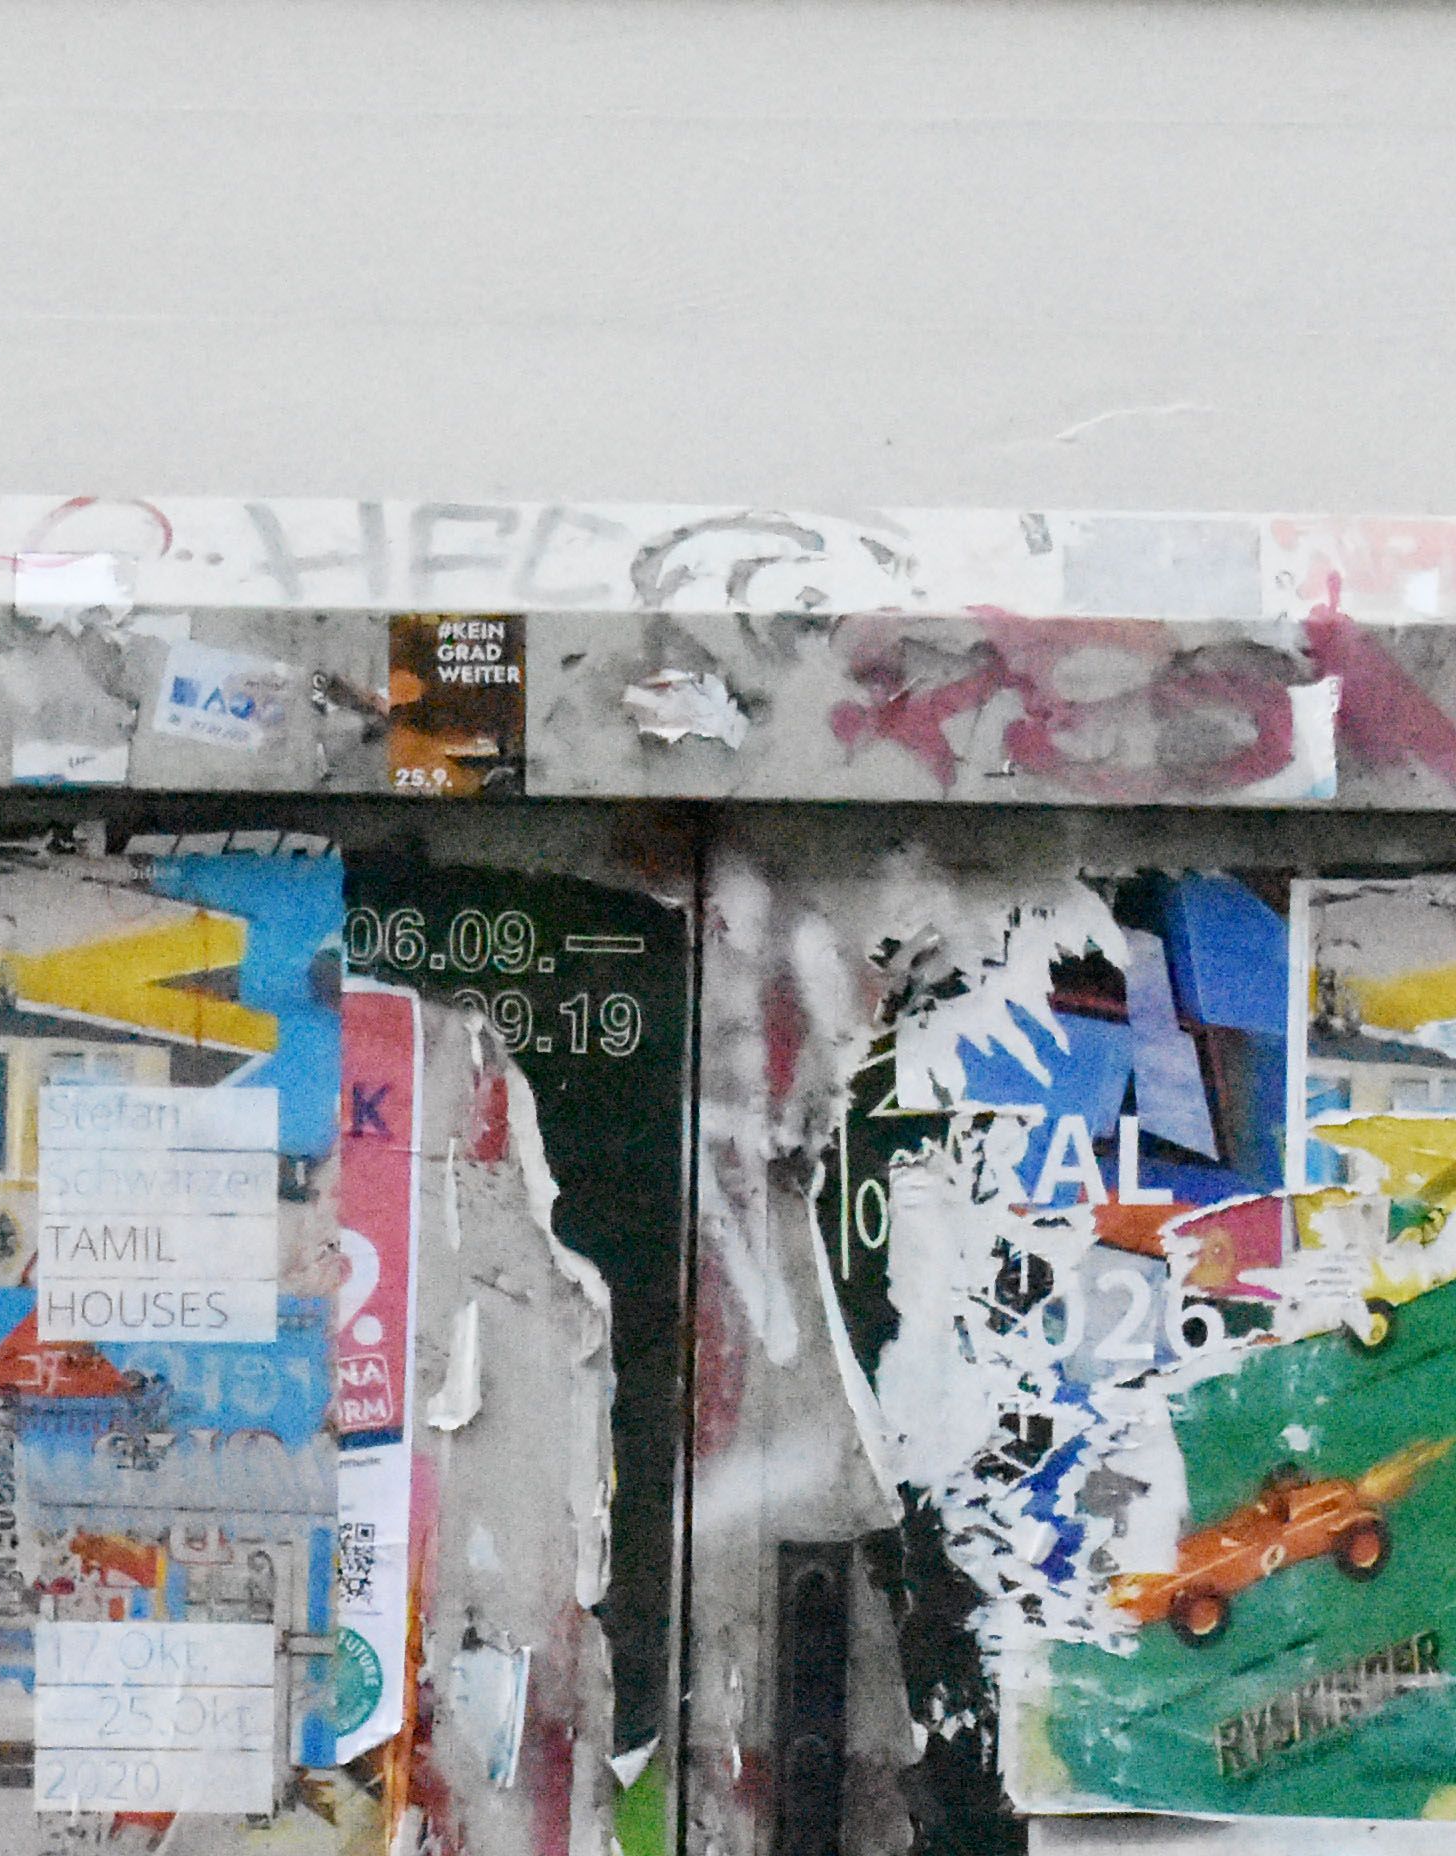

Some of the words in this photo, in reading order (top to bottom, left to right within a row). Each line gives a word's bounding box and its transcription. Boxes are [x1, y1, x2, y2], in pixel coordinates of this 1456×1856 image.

[439, 621, 505, 641] #KEIN
[438, 643, 502, 662] GRAD
[438, 665, 521, 684] WEITER
[45, 1225, 176, 1262] TAMIL
[47, 1291, 229, 1329] HOUSES
